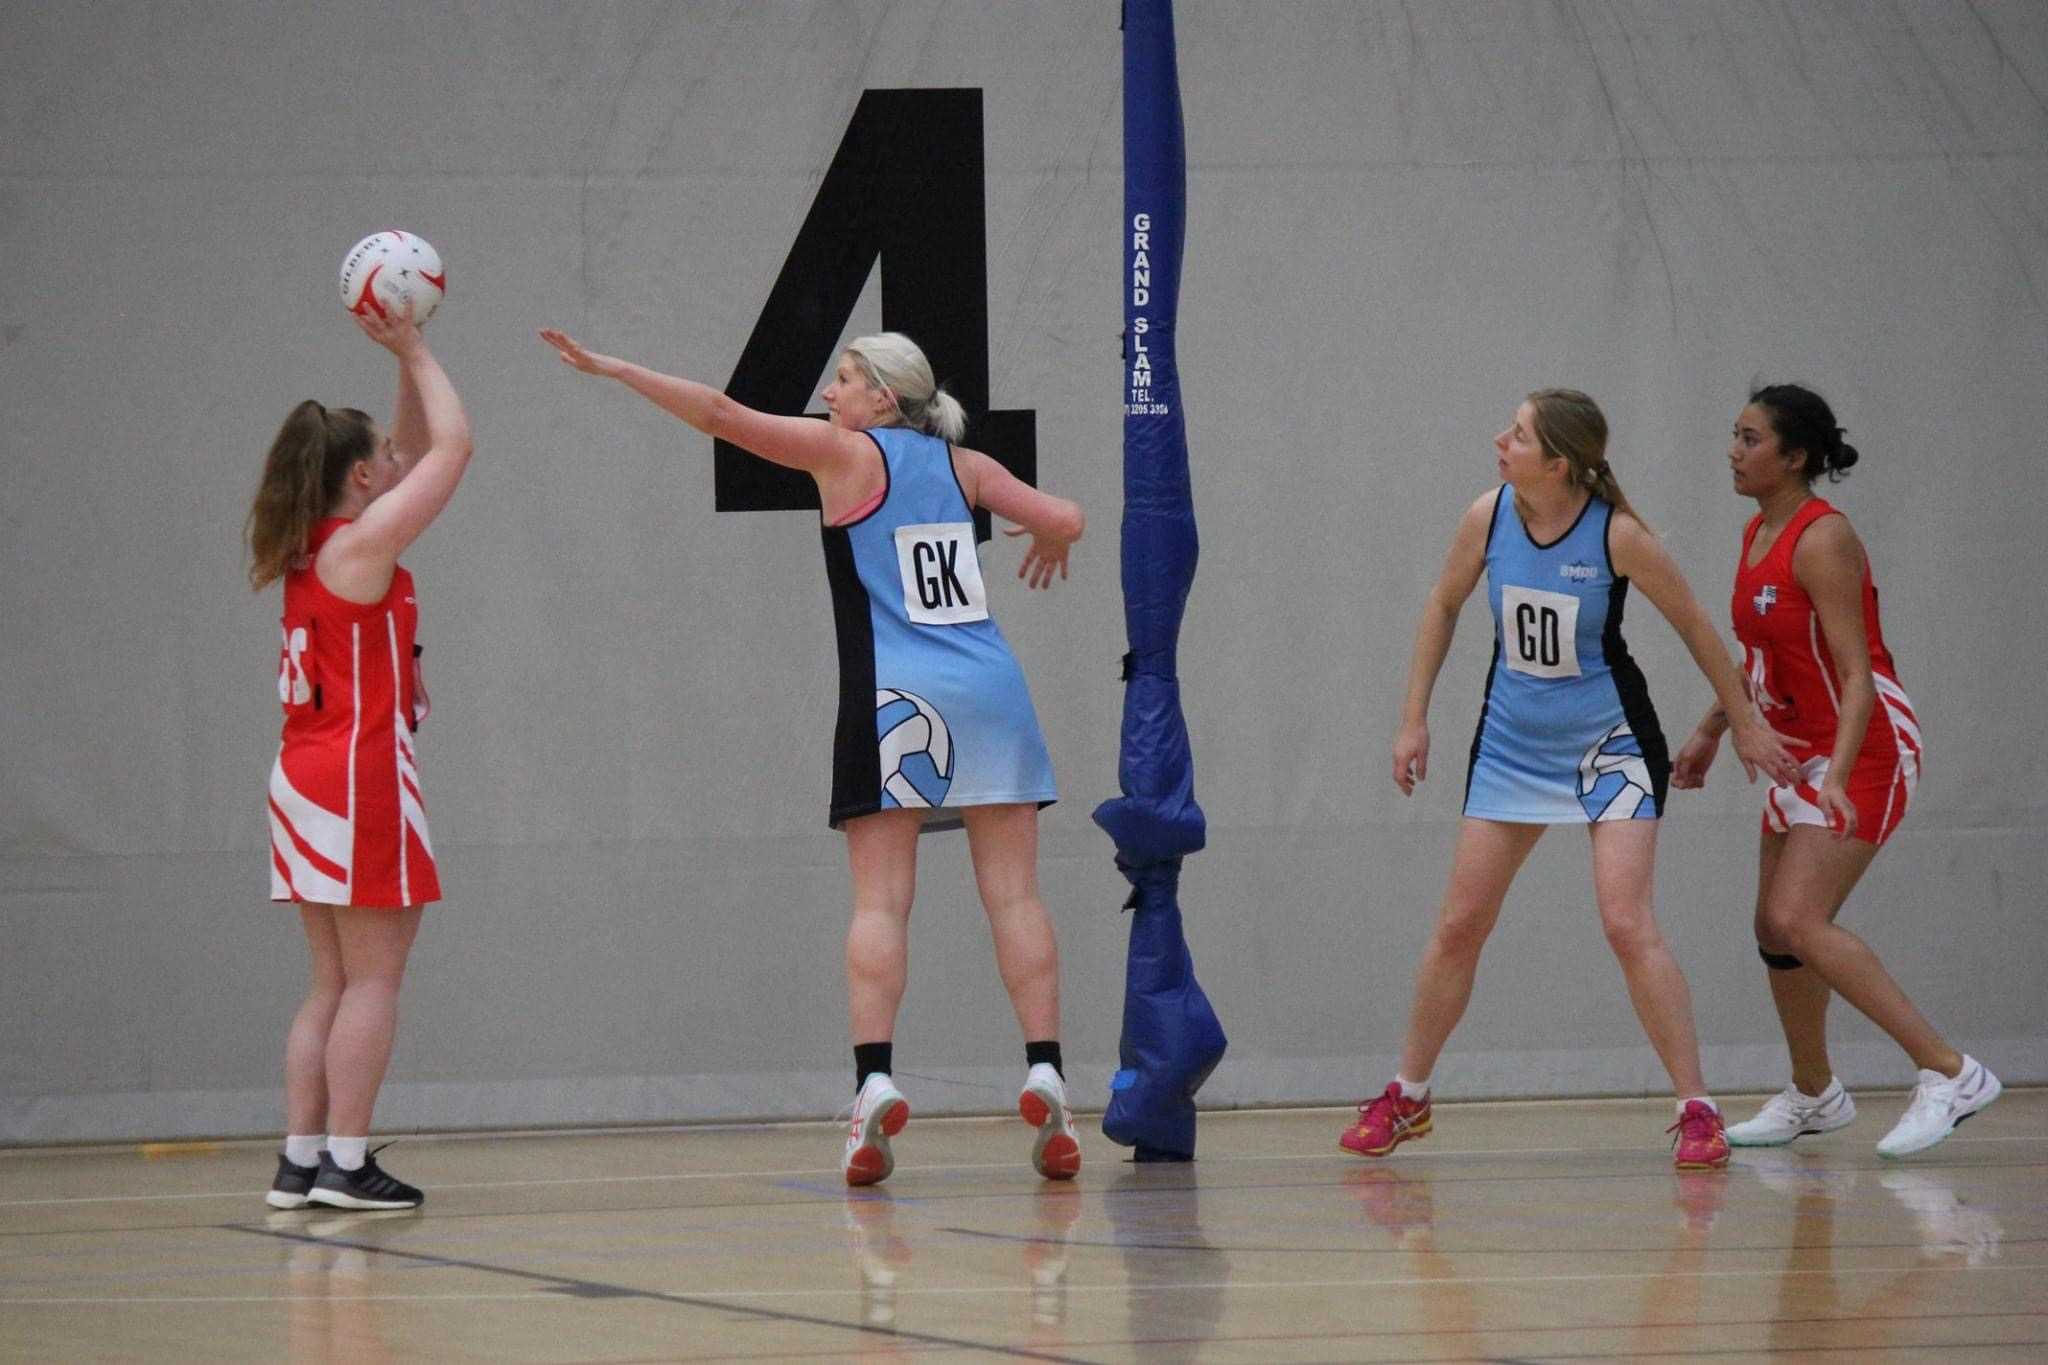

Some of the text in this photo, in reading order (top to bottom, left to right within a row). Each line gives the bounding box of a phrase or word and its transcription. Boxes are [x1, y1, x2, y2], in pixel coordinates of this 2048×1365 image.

[714, 88, 1036, 541] 4
[1133, 213, 1150, 387] GRAND SLAM
[1131, 388, 1154, 402] TEL.
[913, 539, 970, 609] GK
[1516, 602, 1560, 667] GD
